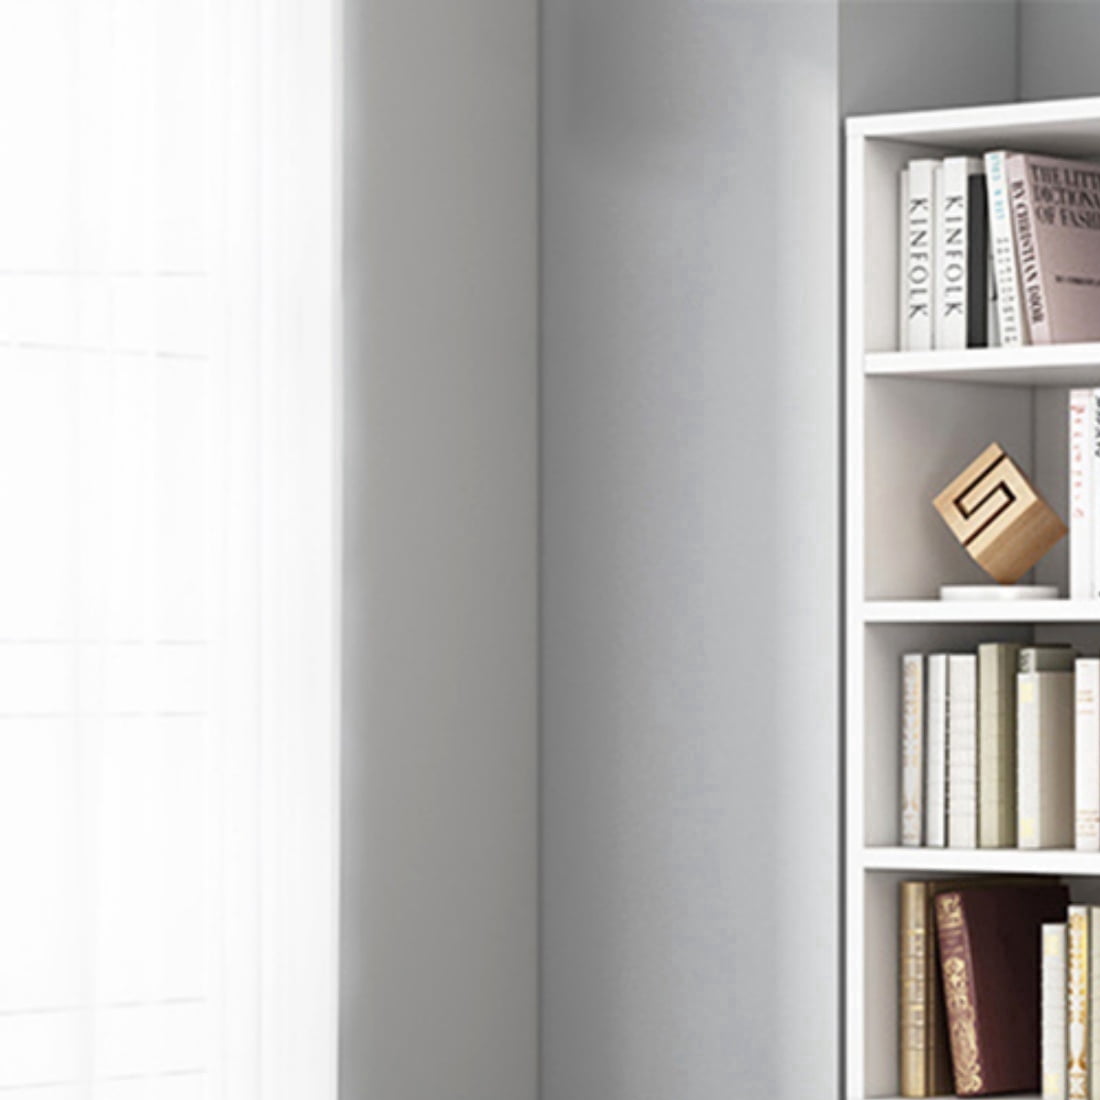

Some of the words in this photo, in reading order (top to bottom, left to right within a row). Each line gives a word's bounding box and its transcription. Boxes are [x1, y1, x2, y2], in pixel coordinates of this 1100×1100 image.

[1030, 164, 1059, 185] THE
[1035, 205, 1055, 225] OF
[908, 197, 929, 319] KINFOLK
[943, 195, 963, 316] KINFOLK
